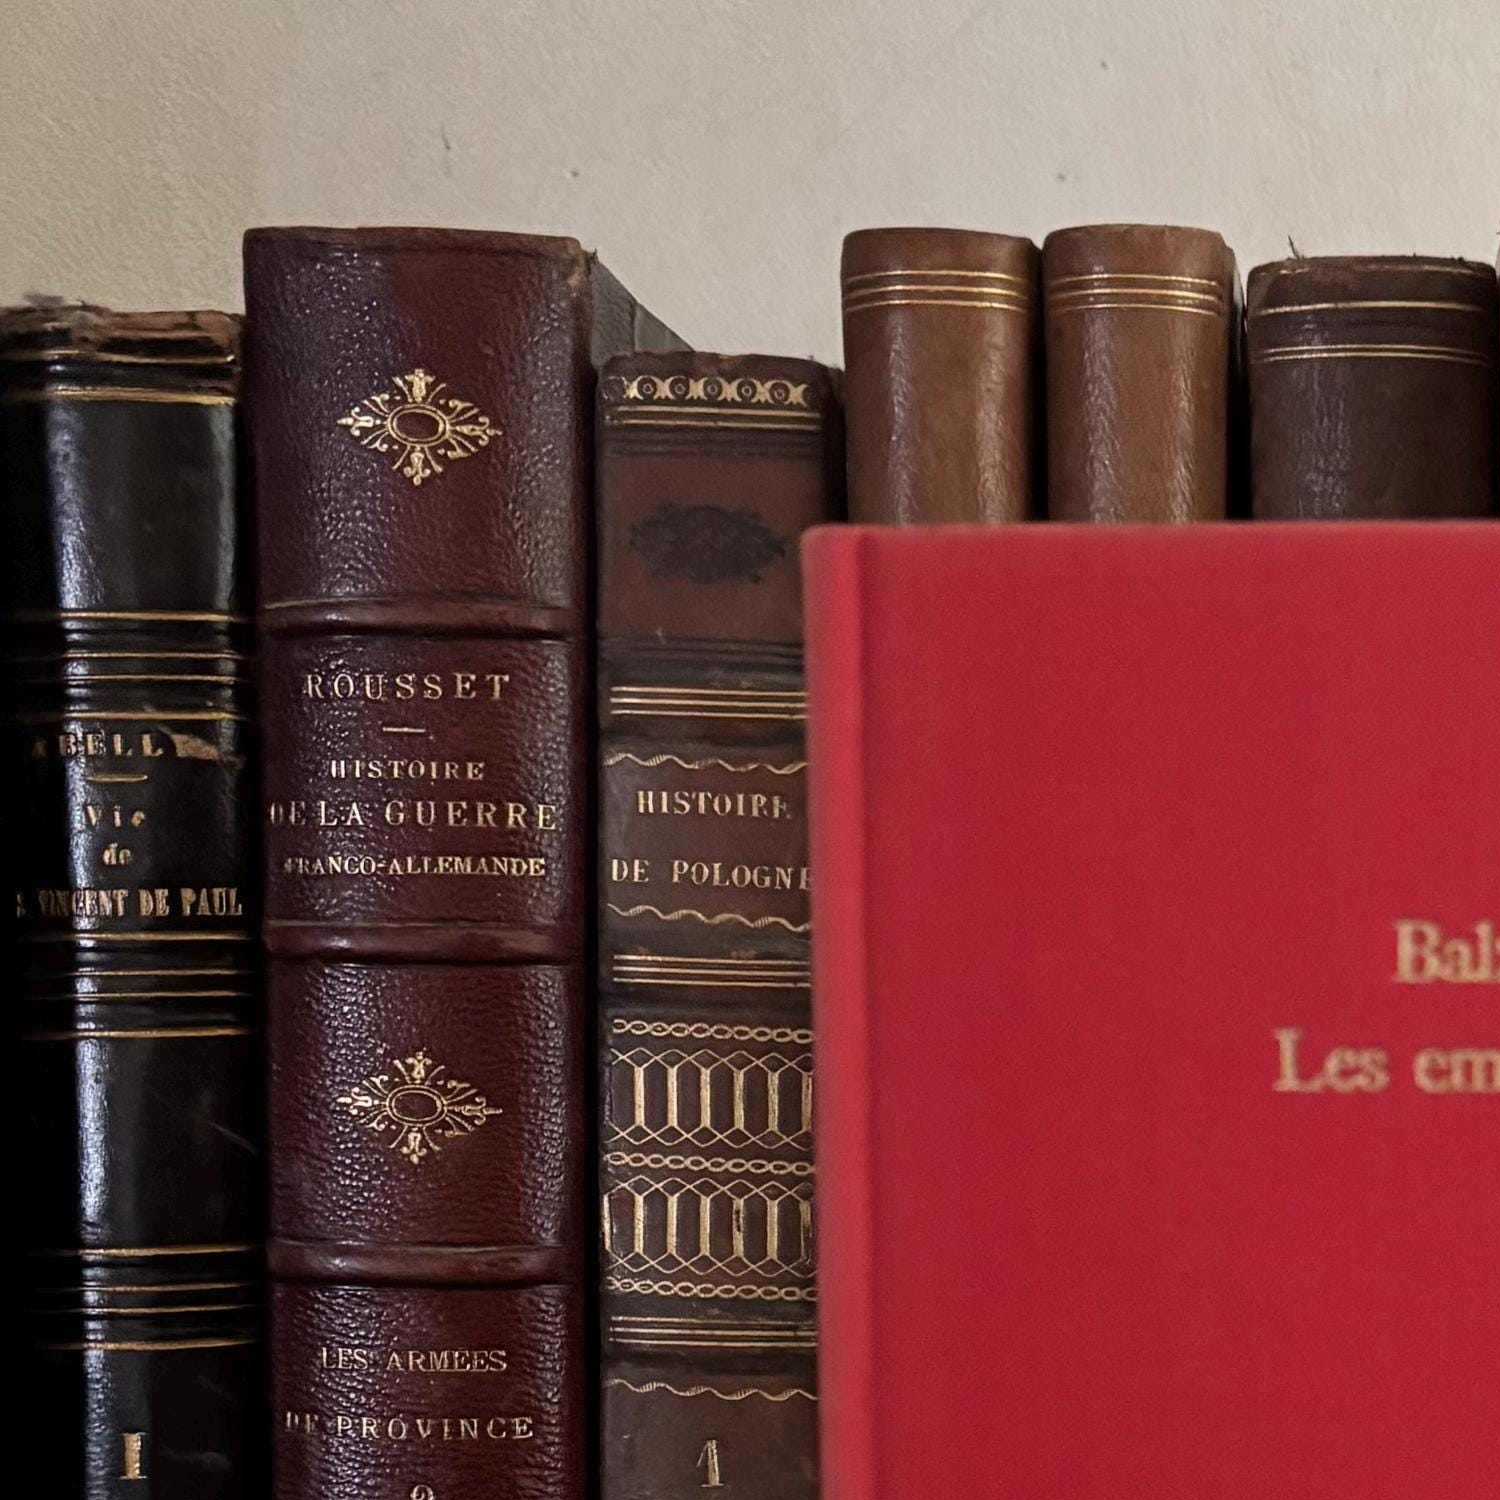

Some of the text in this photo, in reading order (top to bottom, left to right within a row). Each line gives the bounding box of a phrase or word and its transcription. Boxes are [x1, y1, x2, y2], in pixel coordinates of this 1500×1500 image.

[305, 673, 510, 701] ROUSSET
[330, 759, 485, 782] HISTOIRE
[319, 800, 365, 827] LA
[384, 801, 558, 830] GUERRE
[636, 790, 793, 819] HISTOIRE
[611, 858, 815, 892] DE POLOGNE
[138, 887, 170, 917] DE
[180, 886, 244, 917] PAUL
[1273, 1027, 1390, 1093] Les
[320, 1347, 368, 1371] LES
[336, 1413, 534, 1441] PROVINCE
[695, 1438, 726, 1488] 1
